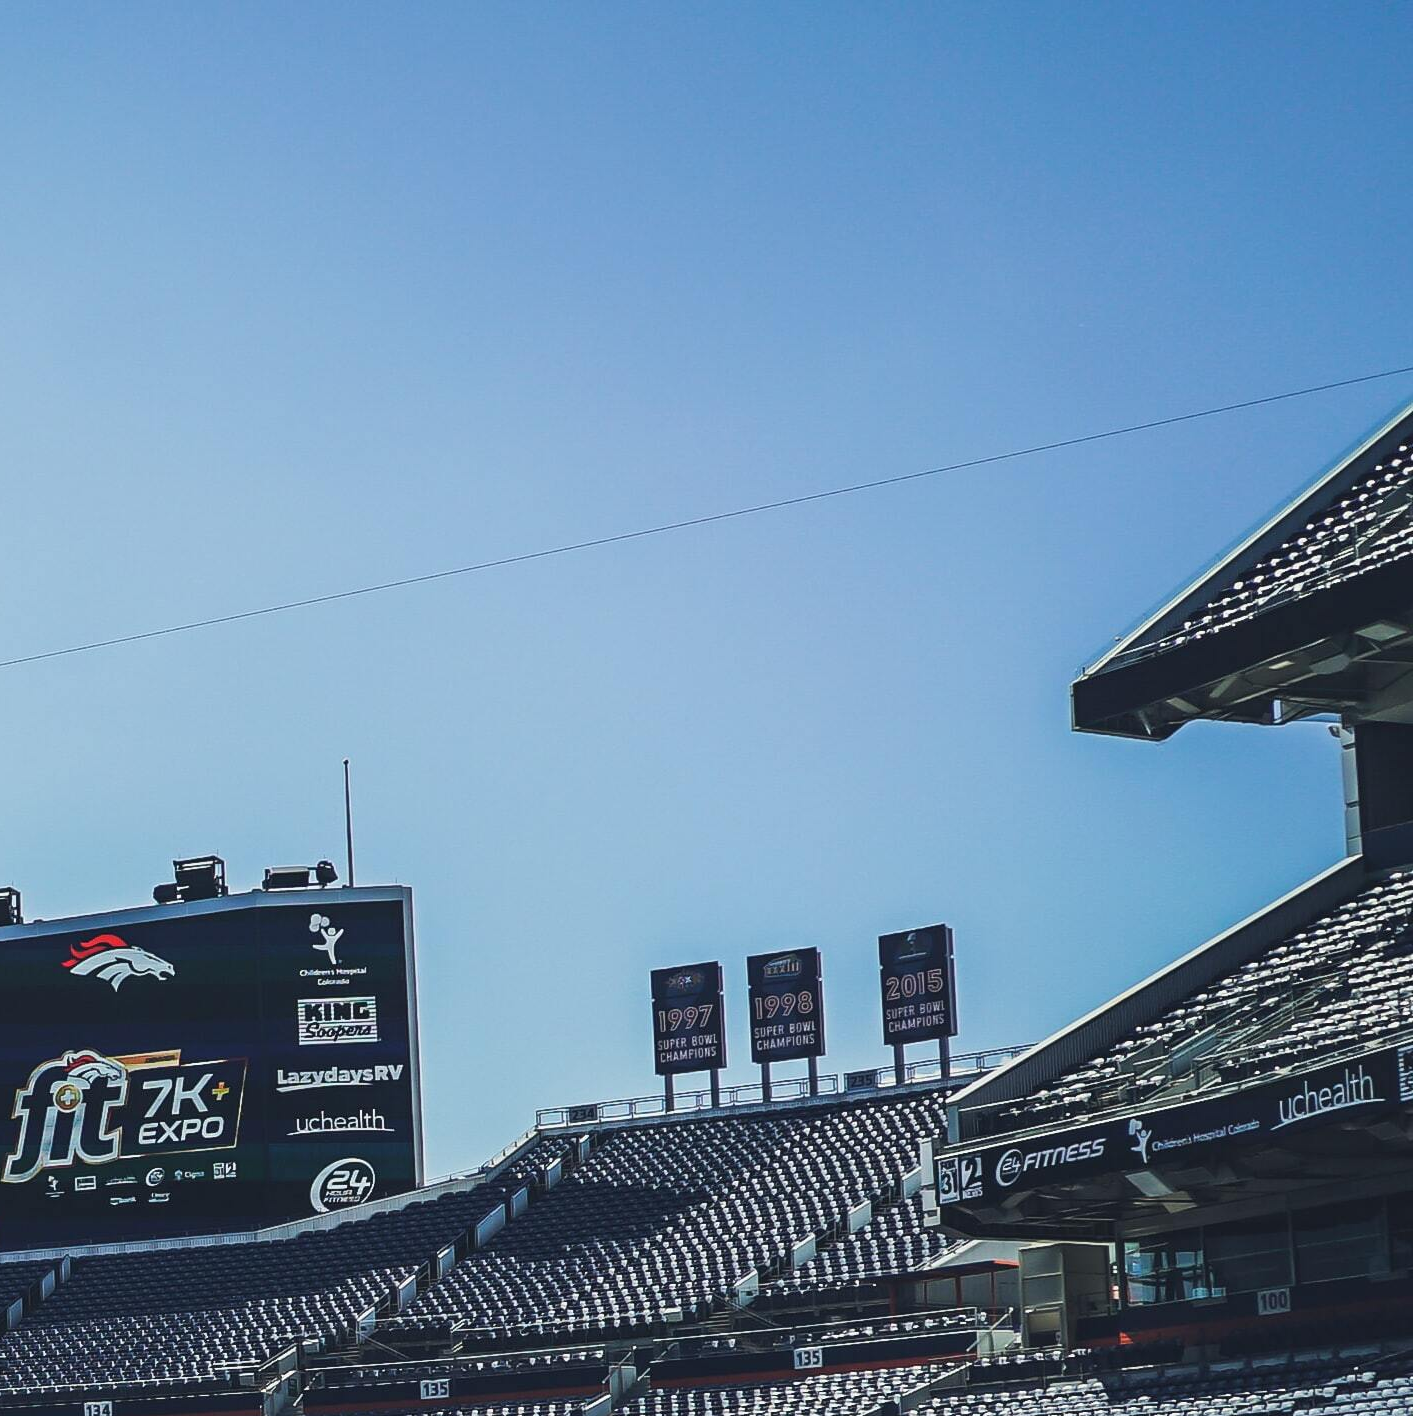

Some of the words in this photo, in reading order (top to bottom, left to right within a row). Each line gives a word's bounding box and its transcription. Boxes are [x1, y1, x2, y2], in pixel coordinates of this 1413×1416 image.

[885, 968, 944, 1001] 2015
[304, 1001, 370, 1021] KING
[755, 990, 813, 1020] 1998
[886, 1004, 915, 1020] SUPER
[919, 1000, 945, 1014] BOWL
[658, 1004, 714, 1033] 1997
[888, 1013, 944, 1033] CHAMPIONS
[304, 1022, 371, 1041] Soopers
[754, 1024, 785, 1039] SUPER
[789, 1020, 817, 1034] BOWL
[657, 1037, 687, 1051] SUPER
[691, 1033, 718, 1047] BOWL
[756, 1033, 815, 1051] CHAMPIONS
[660, 1046, 717, 1063] CHAMPIONS
[851, 1074, 872, 1087] 235
[1279, 1064, 1374, 1122] uchealth
[296, 1108, 385, 1132] uchealth
[572, 1108, 595, 1120] 234
[138, 1116, 225, 1145] EXPO
[1002, 1157, 1021, 1173] 24
[1023, 1138, 1107, 1172] FITNESS
[327, 1169, 371, 1195] 24
[941, 1168, 957, 1194] 31
[1260, 1292, 1287, 1311] 100
[796, 1352, 820, 1368] 135
[423, 1383, 448, 1397] 135
